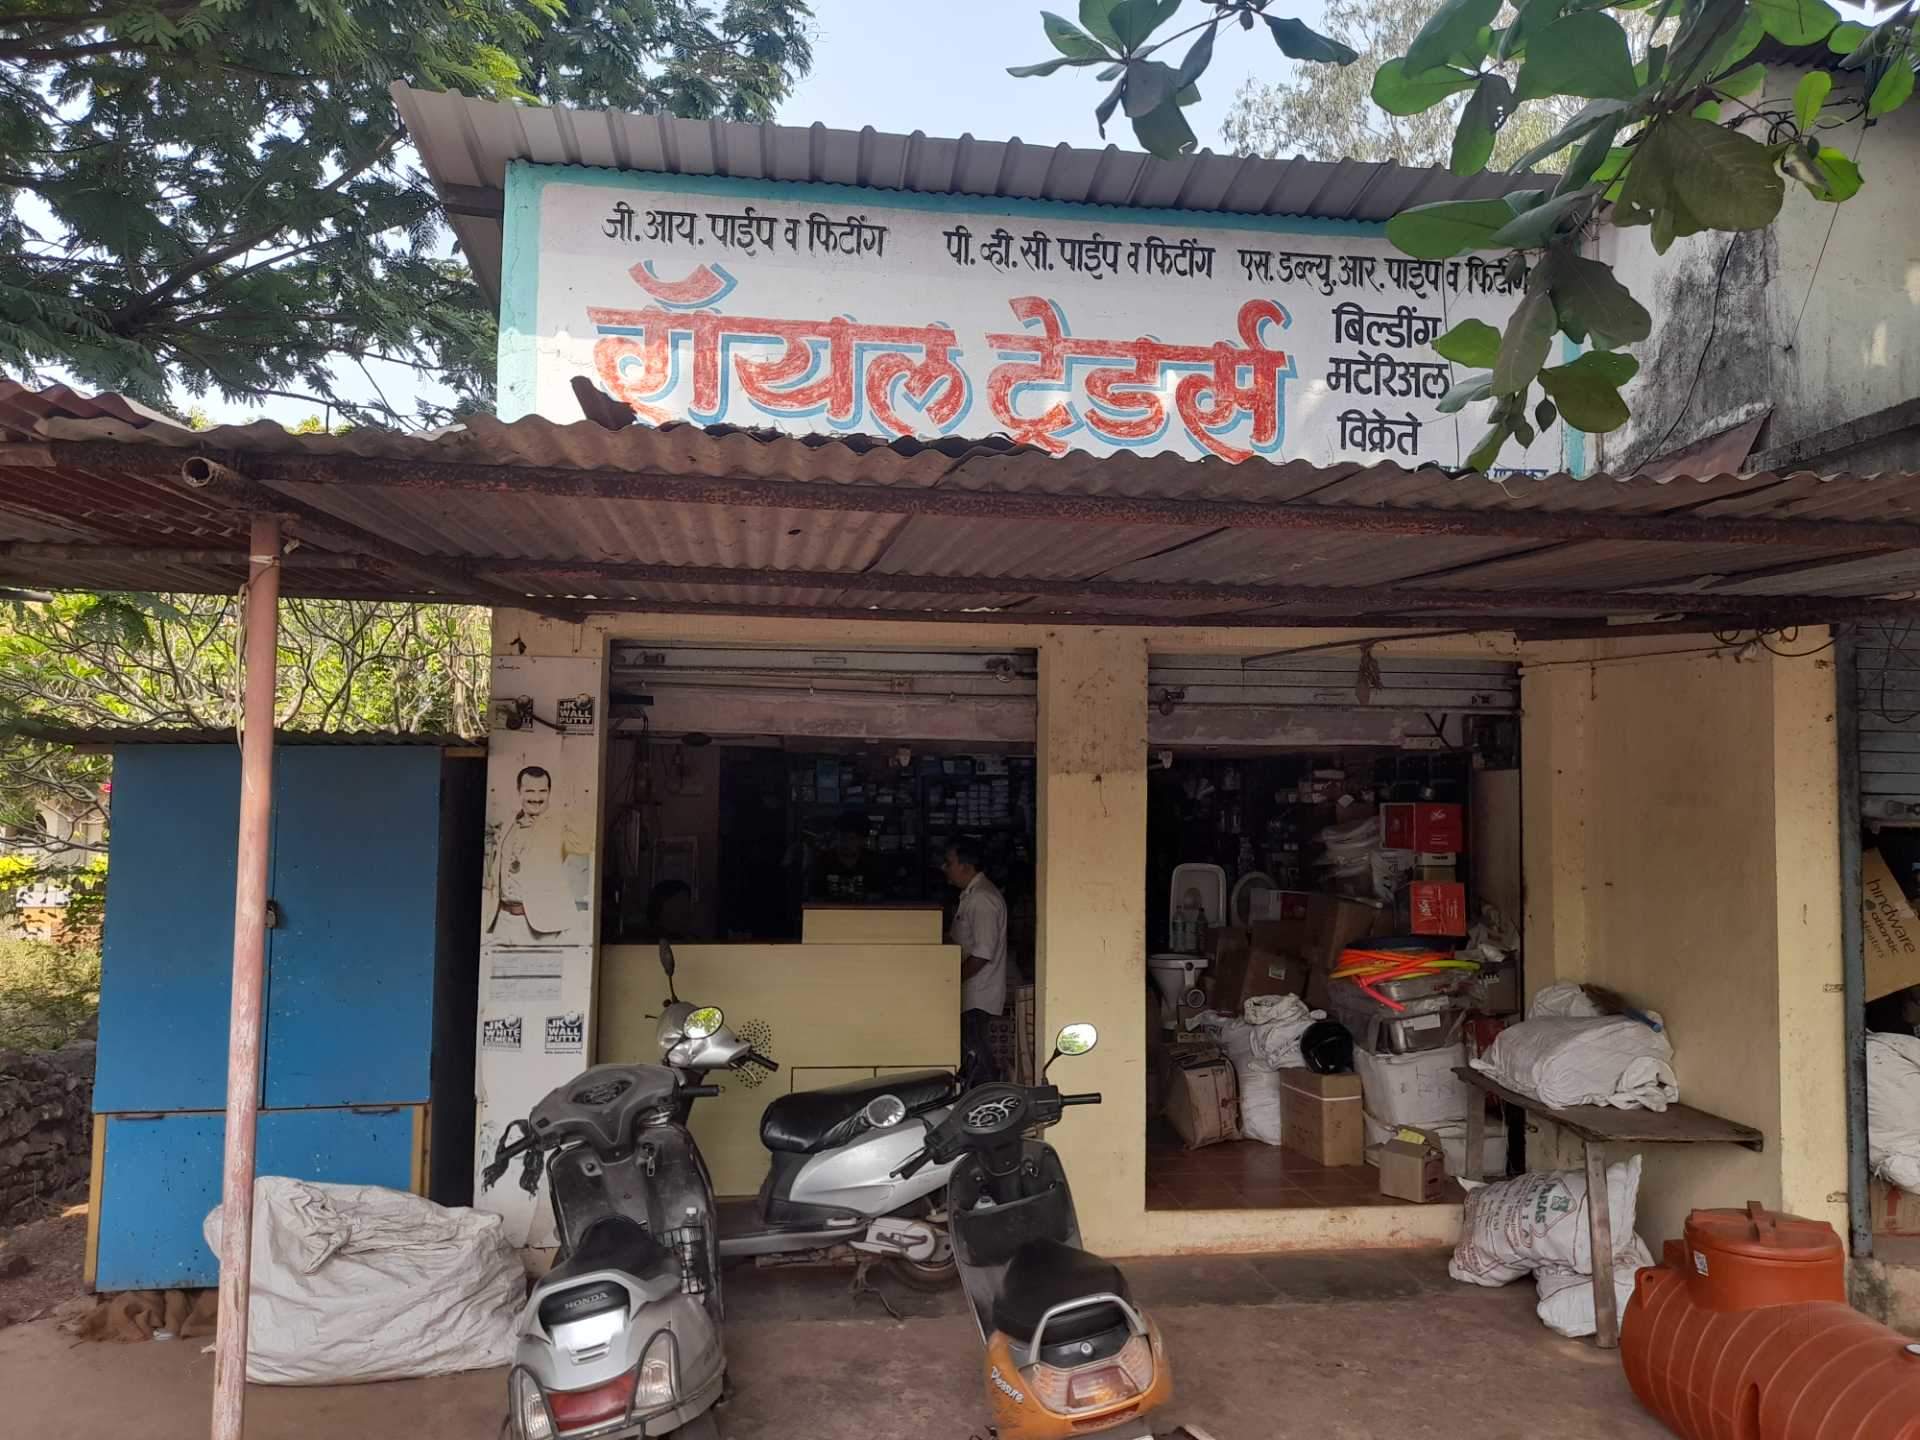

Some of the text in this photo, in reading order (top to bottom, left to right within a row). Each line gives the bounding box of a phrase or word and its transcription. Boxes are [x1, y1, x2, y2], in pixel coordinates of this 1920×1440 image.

[705, 207, 779, 256] पाईप
[785, 218, 800, 250] व
[805, 212, 888, 257] फिटींग
[1056, 232, 1122, 280] पाईप
[1128, 242, 1143, 274] व
[1144, 236, 1216, 279] फिटींग
[1447, 262, 1460, 293] व
[1337, 408, 1422, 455] विक्रेते
[560, 701, 577, 710] JK
[559, 710, 592, 718] WALL
[559, 717, 592, 725] PUTTY
[1866, 879, 1916, 953] hindware
[485, 1021, 504, 1030] JK
[548, 1018, 566, 1028] JK
[484, 1029, 521, 1037] WHITE
[548, 1027, 581, 1036] WALL
[564, 1291, 609, 1310] HONDA
